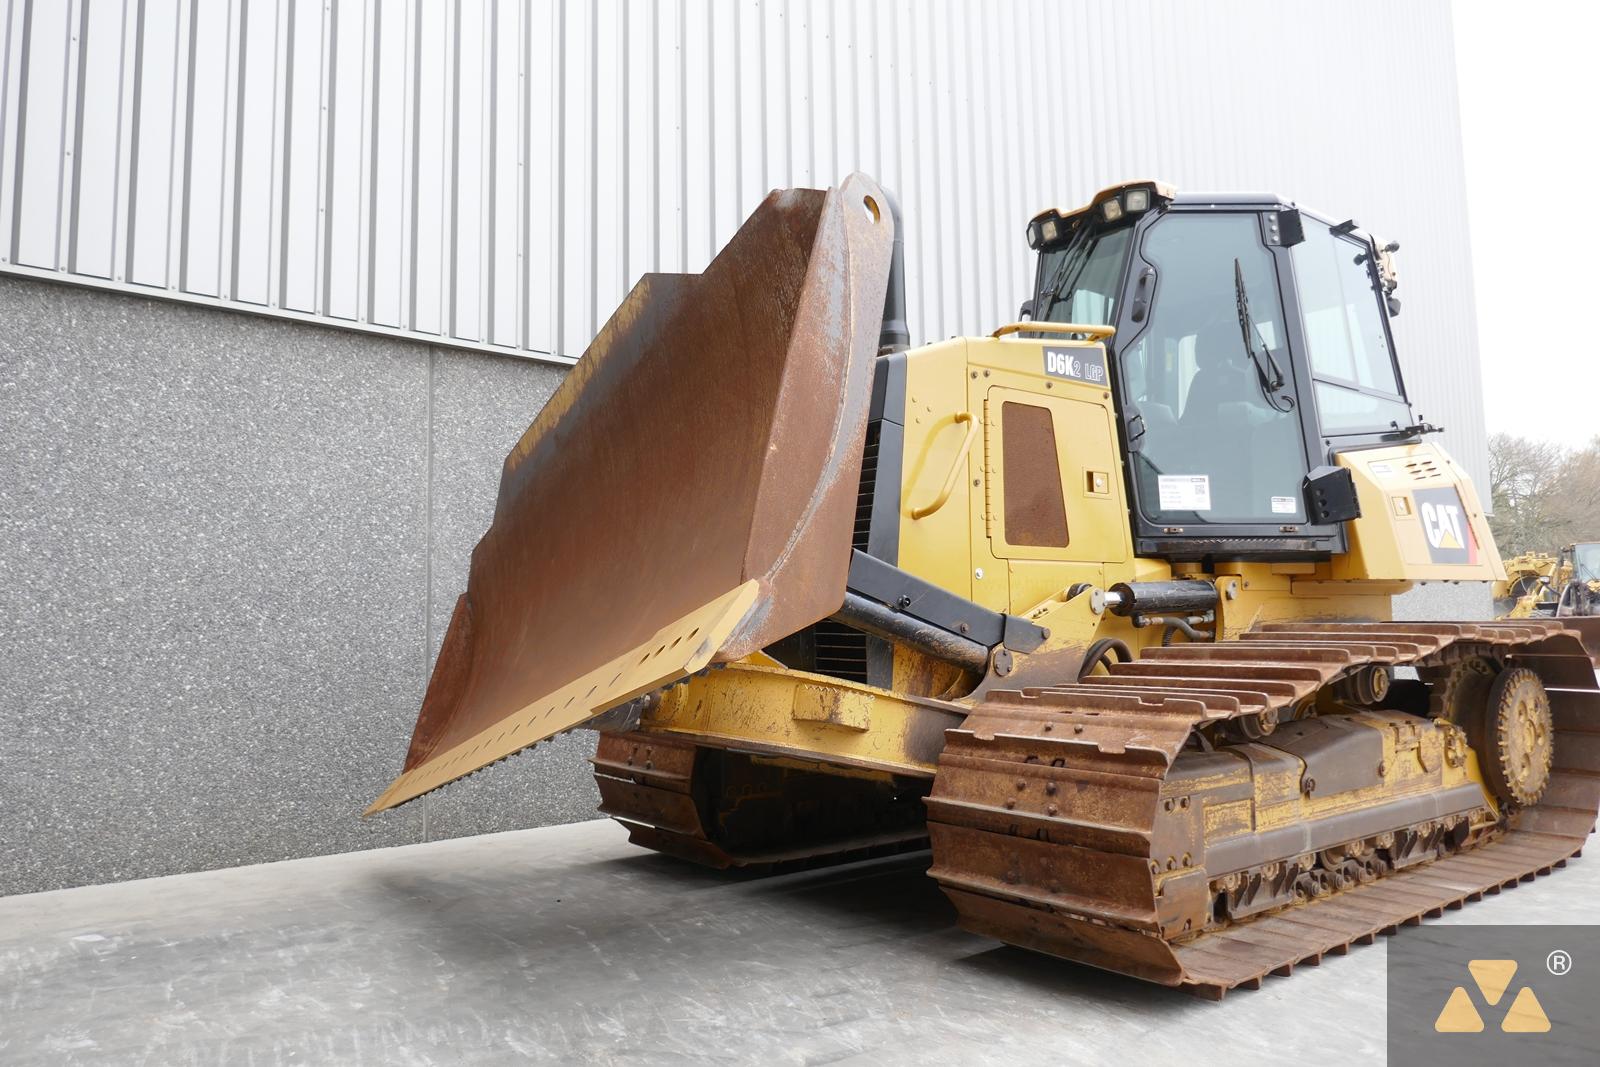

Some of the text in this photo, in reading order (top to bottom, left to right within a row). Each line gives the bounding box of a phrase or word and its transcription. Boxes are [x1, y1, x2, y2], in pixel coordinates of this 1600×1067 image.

[1047, 351, 1104, 382] D6K2 LGP
[1421, 502, 1465, 549] CAT
